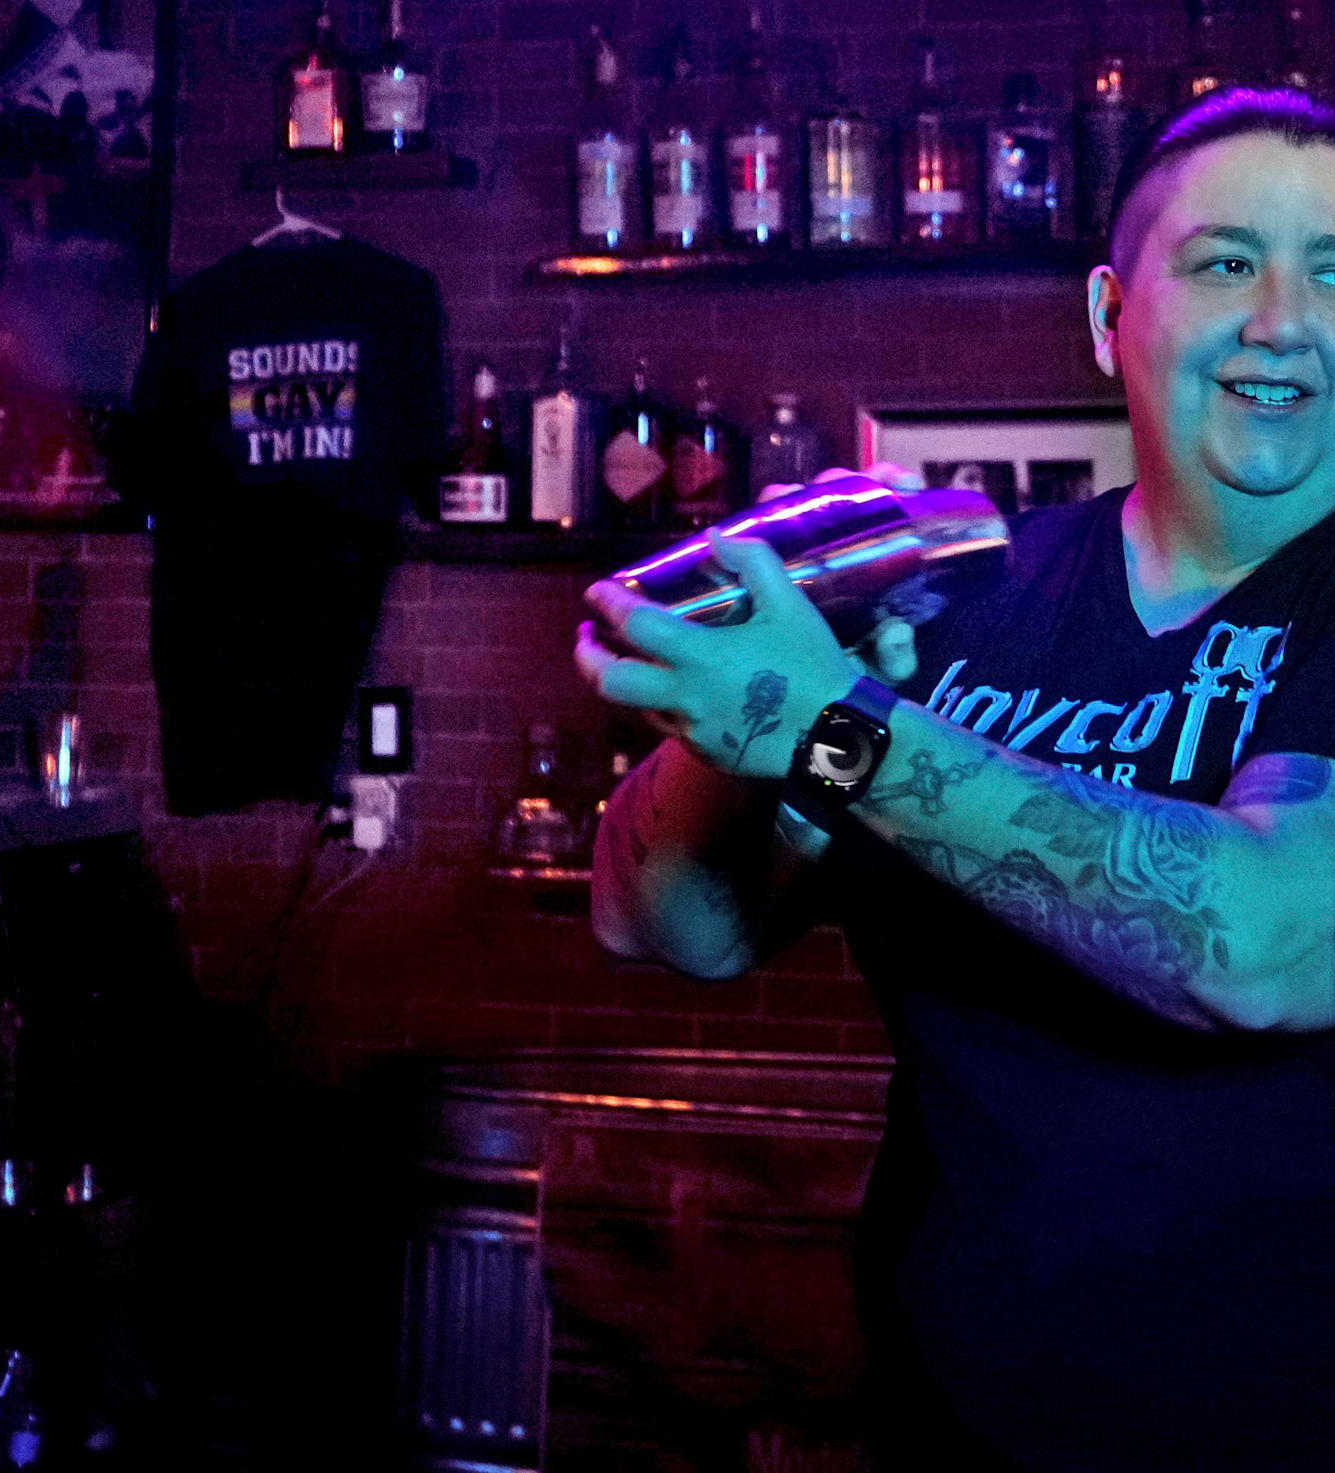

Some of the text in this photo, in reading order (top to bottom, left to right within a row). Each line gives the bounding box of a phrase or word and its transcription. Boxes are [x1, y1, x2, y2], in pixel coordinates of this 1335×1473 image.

[252, 381, 348, 426] GAY
[248, 424, 354, 466] I'M IN!
[1061, 762, 1137, 790] AR
